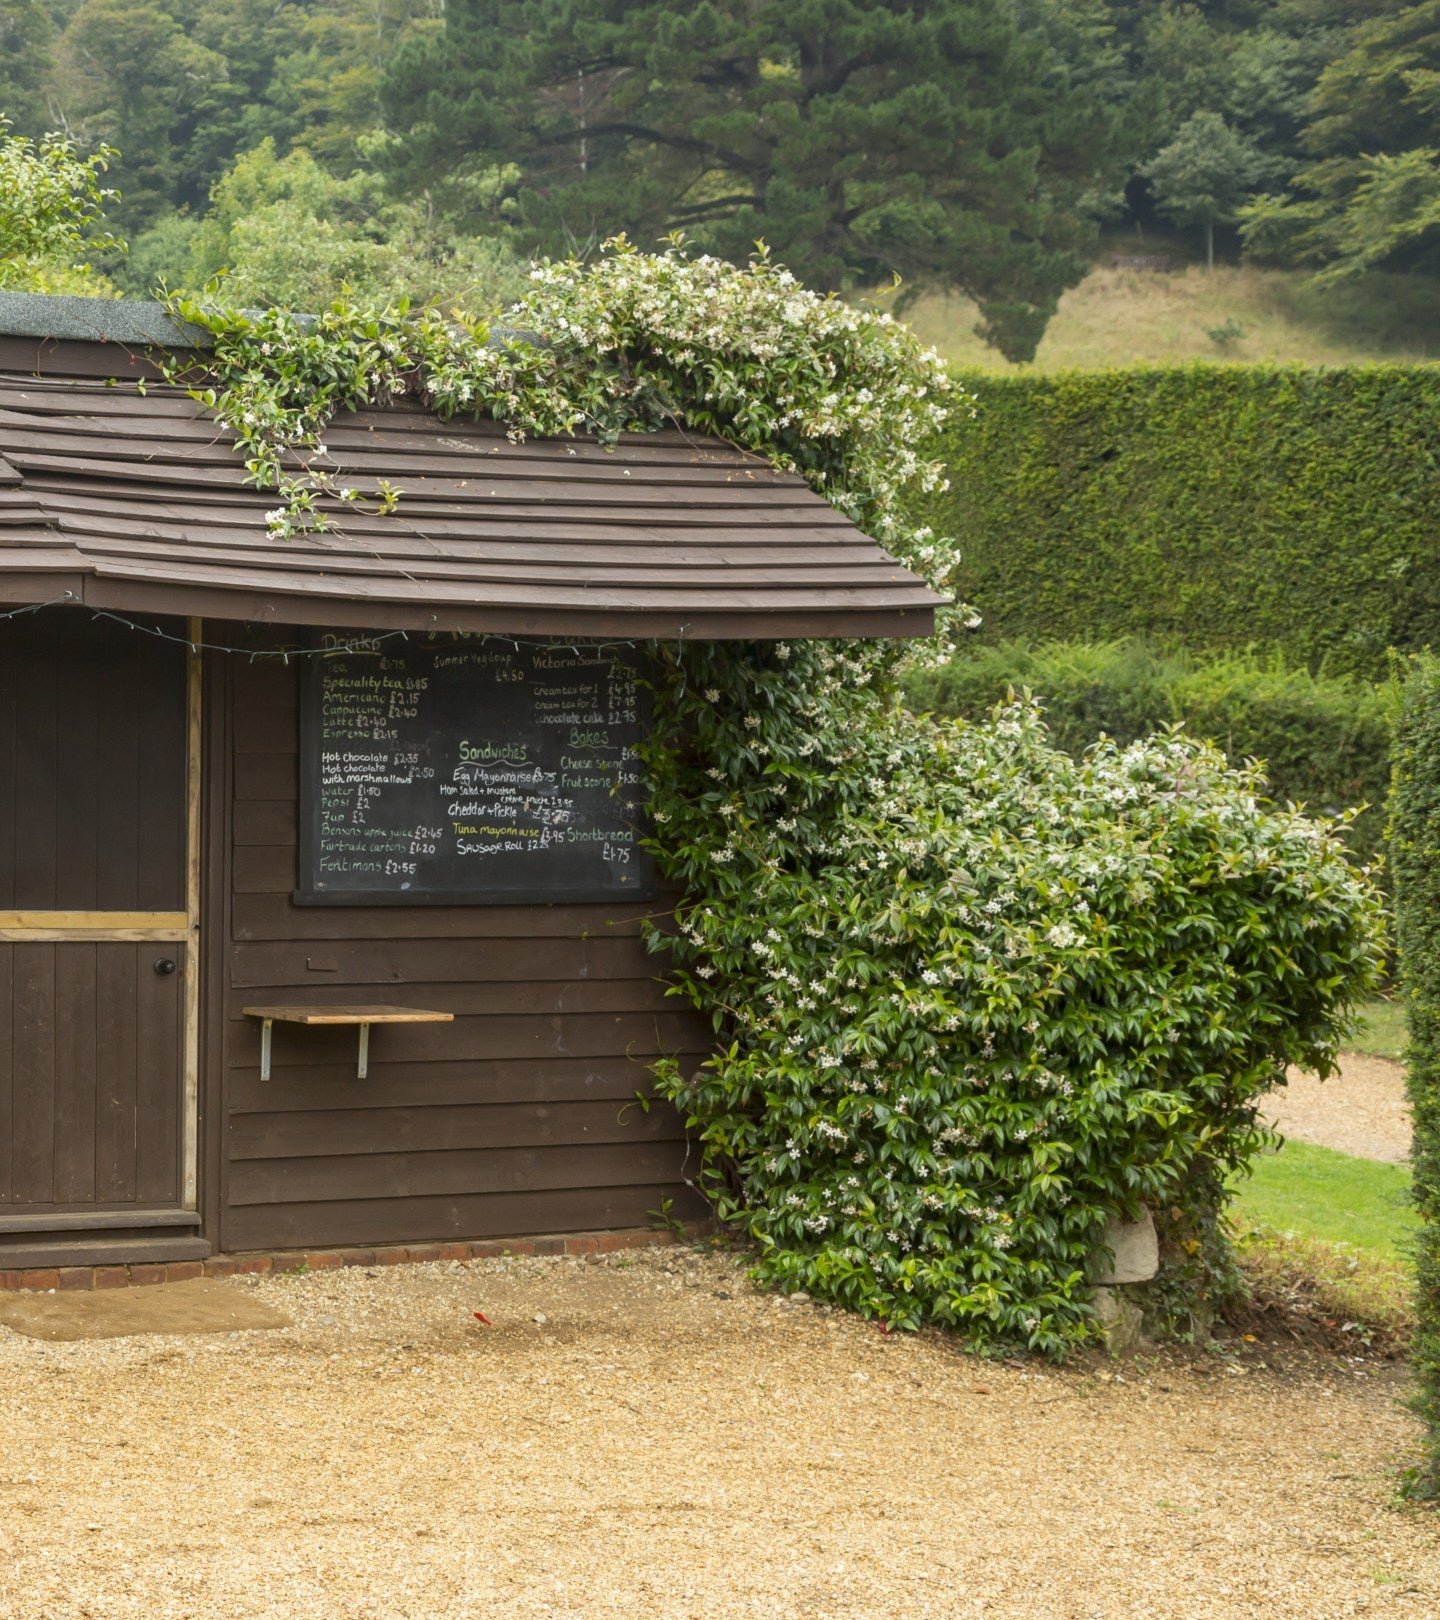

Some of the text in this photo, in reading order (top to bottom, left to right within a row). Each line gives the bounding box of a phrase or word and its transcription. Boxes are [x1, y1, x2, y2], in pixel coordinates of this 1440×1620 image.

[321, 633, 381, 651] Drinks
[323, 659, 348, 673] Tea
[532, 655, 576, 669] Victoria
[322, 676, 381, 692] Speciality
[382, 676, 405, 689] tea
[533, 687, 561, 696] cream
[562, 685, 577, 695] tea
[579, 683, 592, 694] for
[322, 691, 386, 704] Americano
[535, 701, 560, 710] cream
[561, 699, 575, 709] tea
[577, 698, 589, 708] for
[591, 697, 599, 708] 2
[322, 704, 383, 719] Cappuccino
[323, 717, 353, 726] Latte
[323, 728, 370, 739] Espresso
[570, 726, 609, 745] Bakes
[459, 740, 527, 760] Sandwiches
[321, 752, 341, 763] Hot
[561, 756, 624, 770] Cheese sone
[322, 764, 342, 774] Hot
[453, 766, 471, 786] Egg
[322, 774, 413, 785] with marshmallows
[561, 773, 611, 788] Fruit scone
[440, 784, 458, 795] Ham
[321, 797, 370, 810] Pepsi £2
[447, 801, 486, 817] Cheddar
[352, 810, 366, 824] £2
[453, 822, 478, 835] Tuna
[480, 826, 539, 839] mayonnaise
[567, 827, 633, 842] Shortbread
[320, 839, 366, 852] Fairtrade
[370, 842, 407, 853] cartons
[320, 856, 417, 875] Fentimans £2.55
